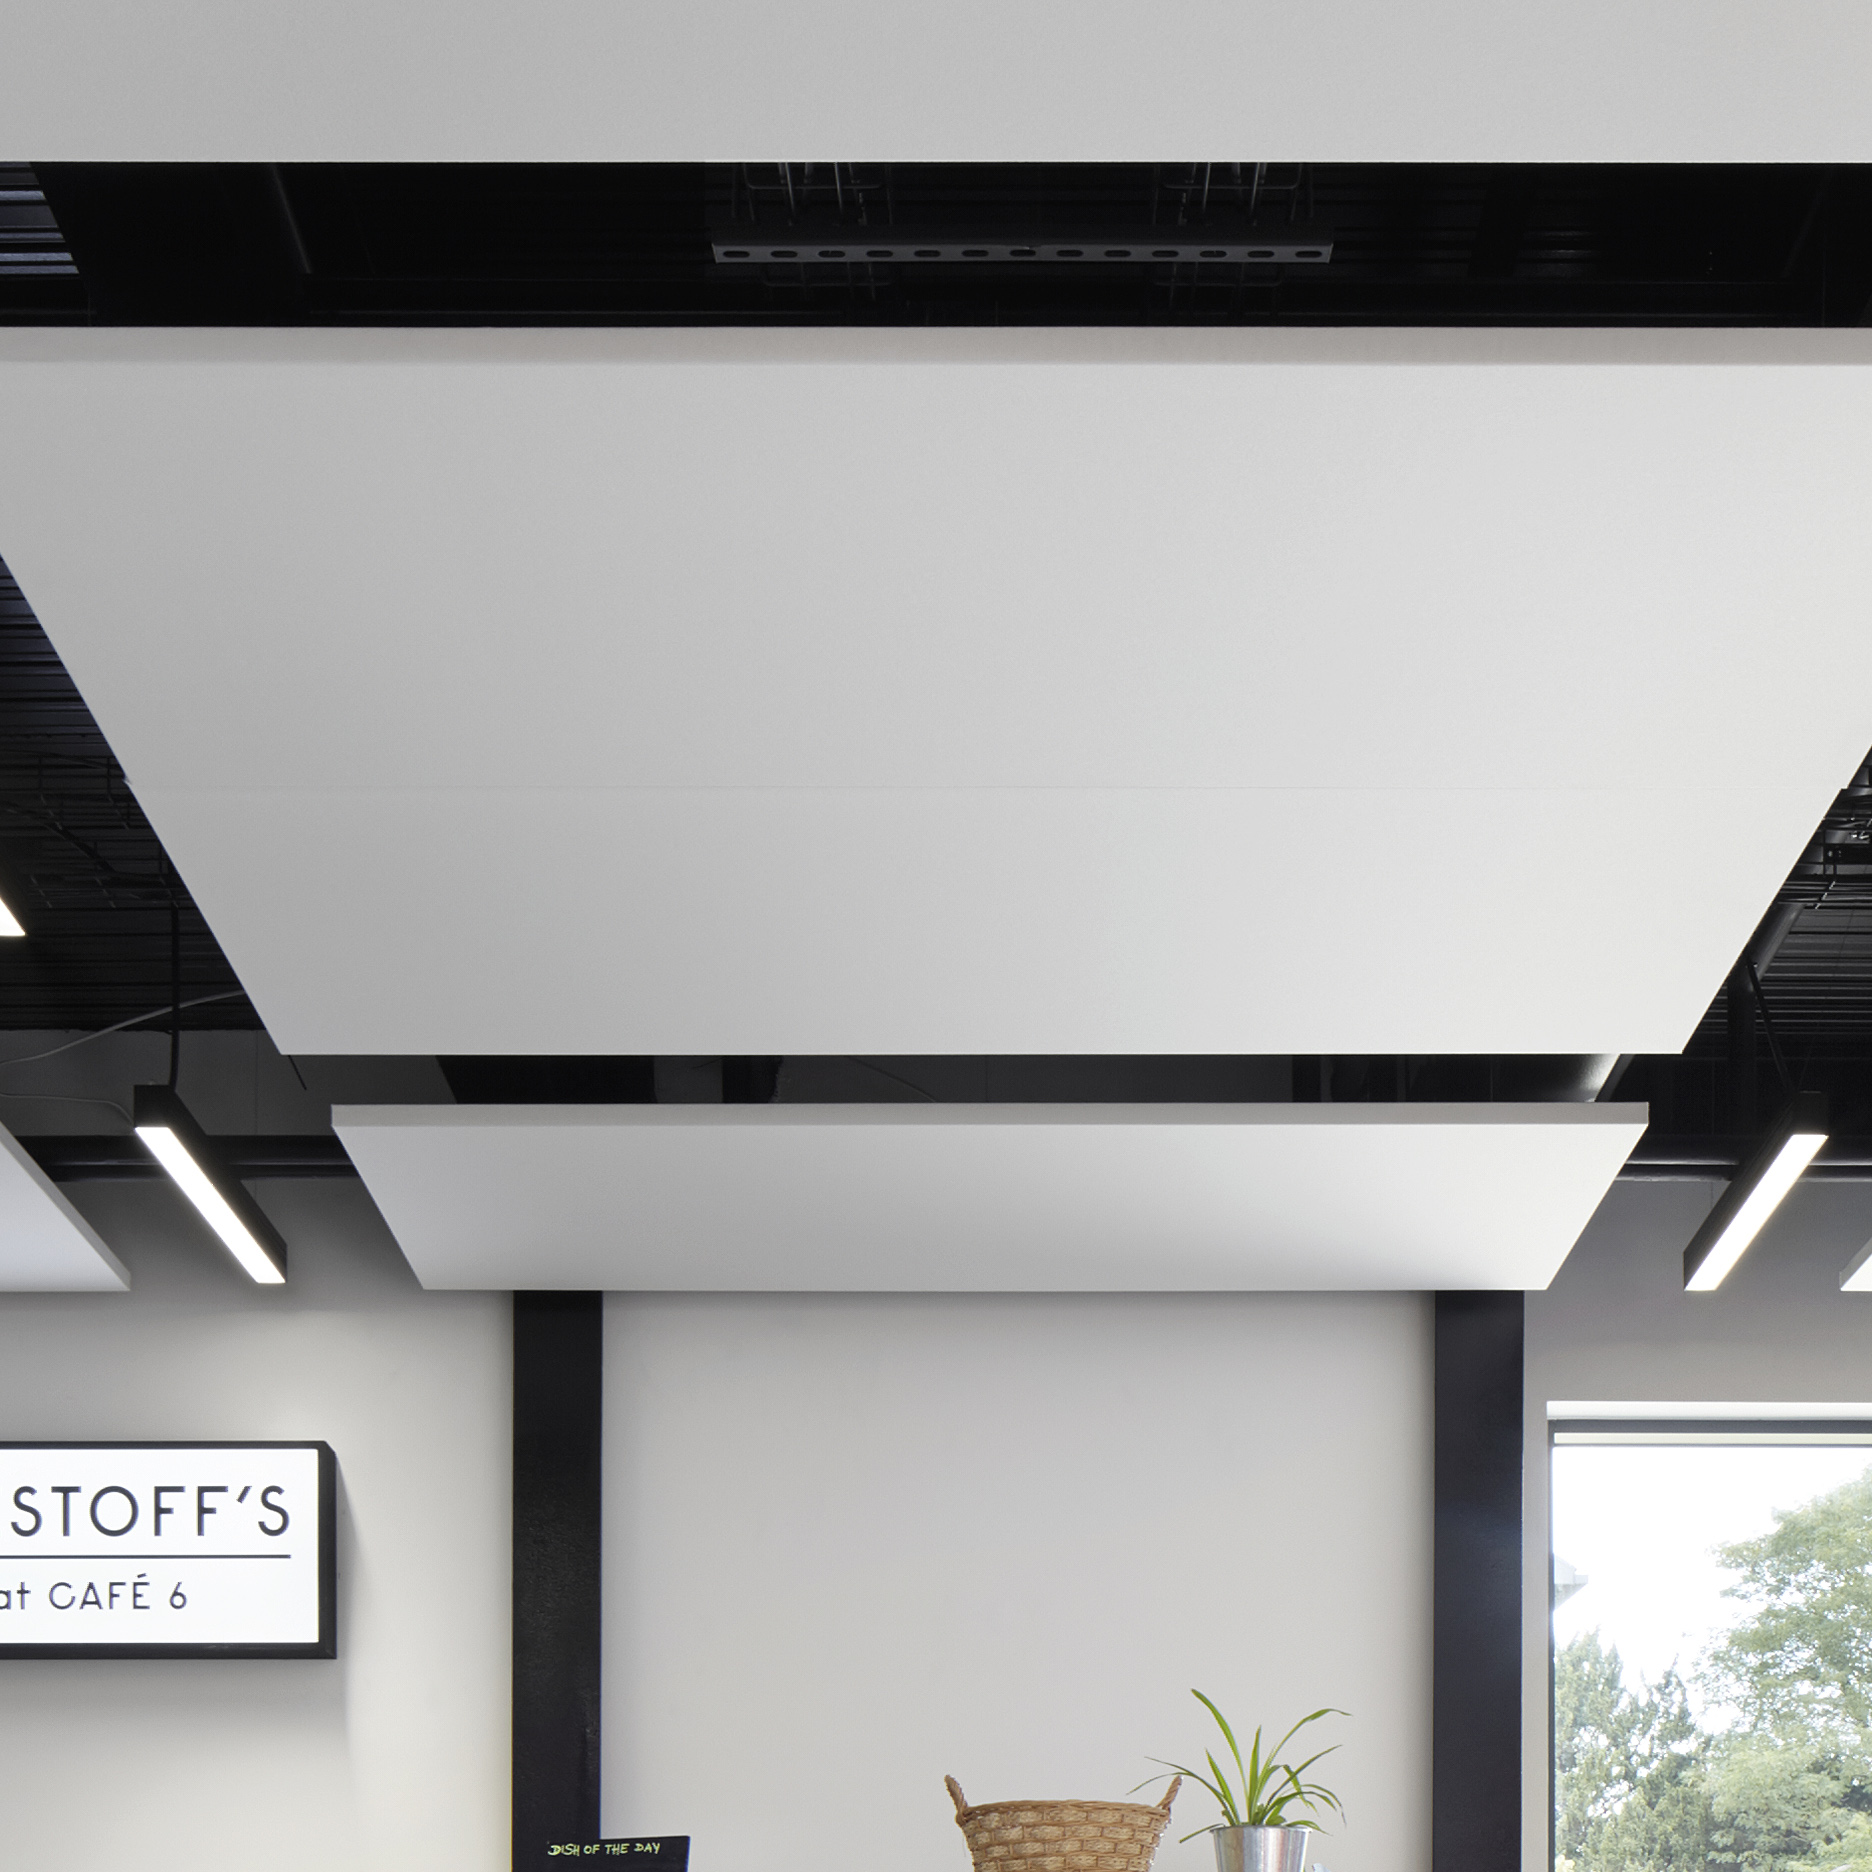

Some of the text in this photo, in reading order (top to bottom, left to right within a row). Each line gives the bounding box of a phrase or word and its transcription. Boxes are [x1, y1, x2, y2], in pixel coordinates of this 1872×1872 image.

[49, 1573, 151, 1610] CAFÉ
[169, 1581, 188, 1610] 6
[548, 1842, 661, 1857] DISH OF THE DAY
